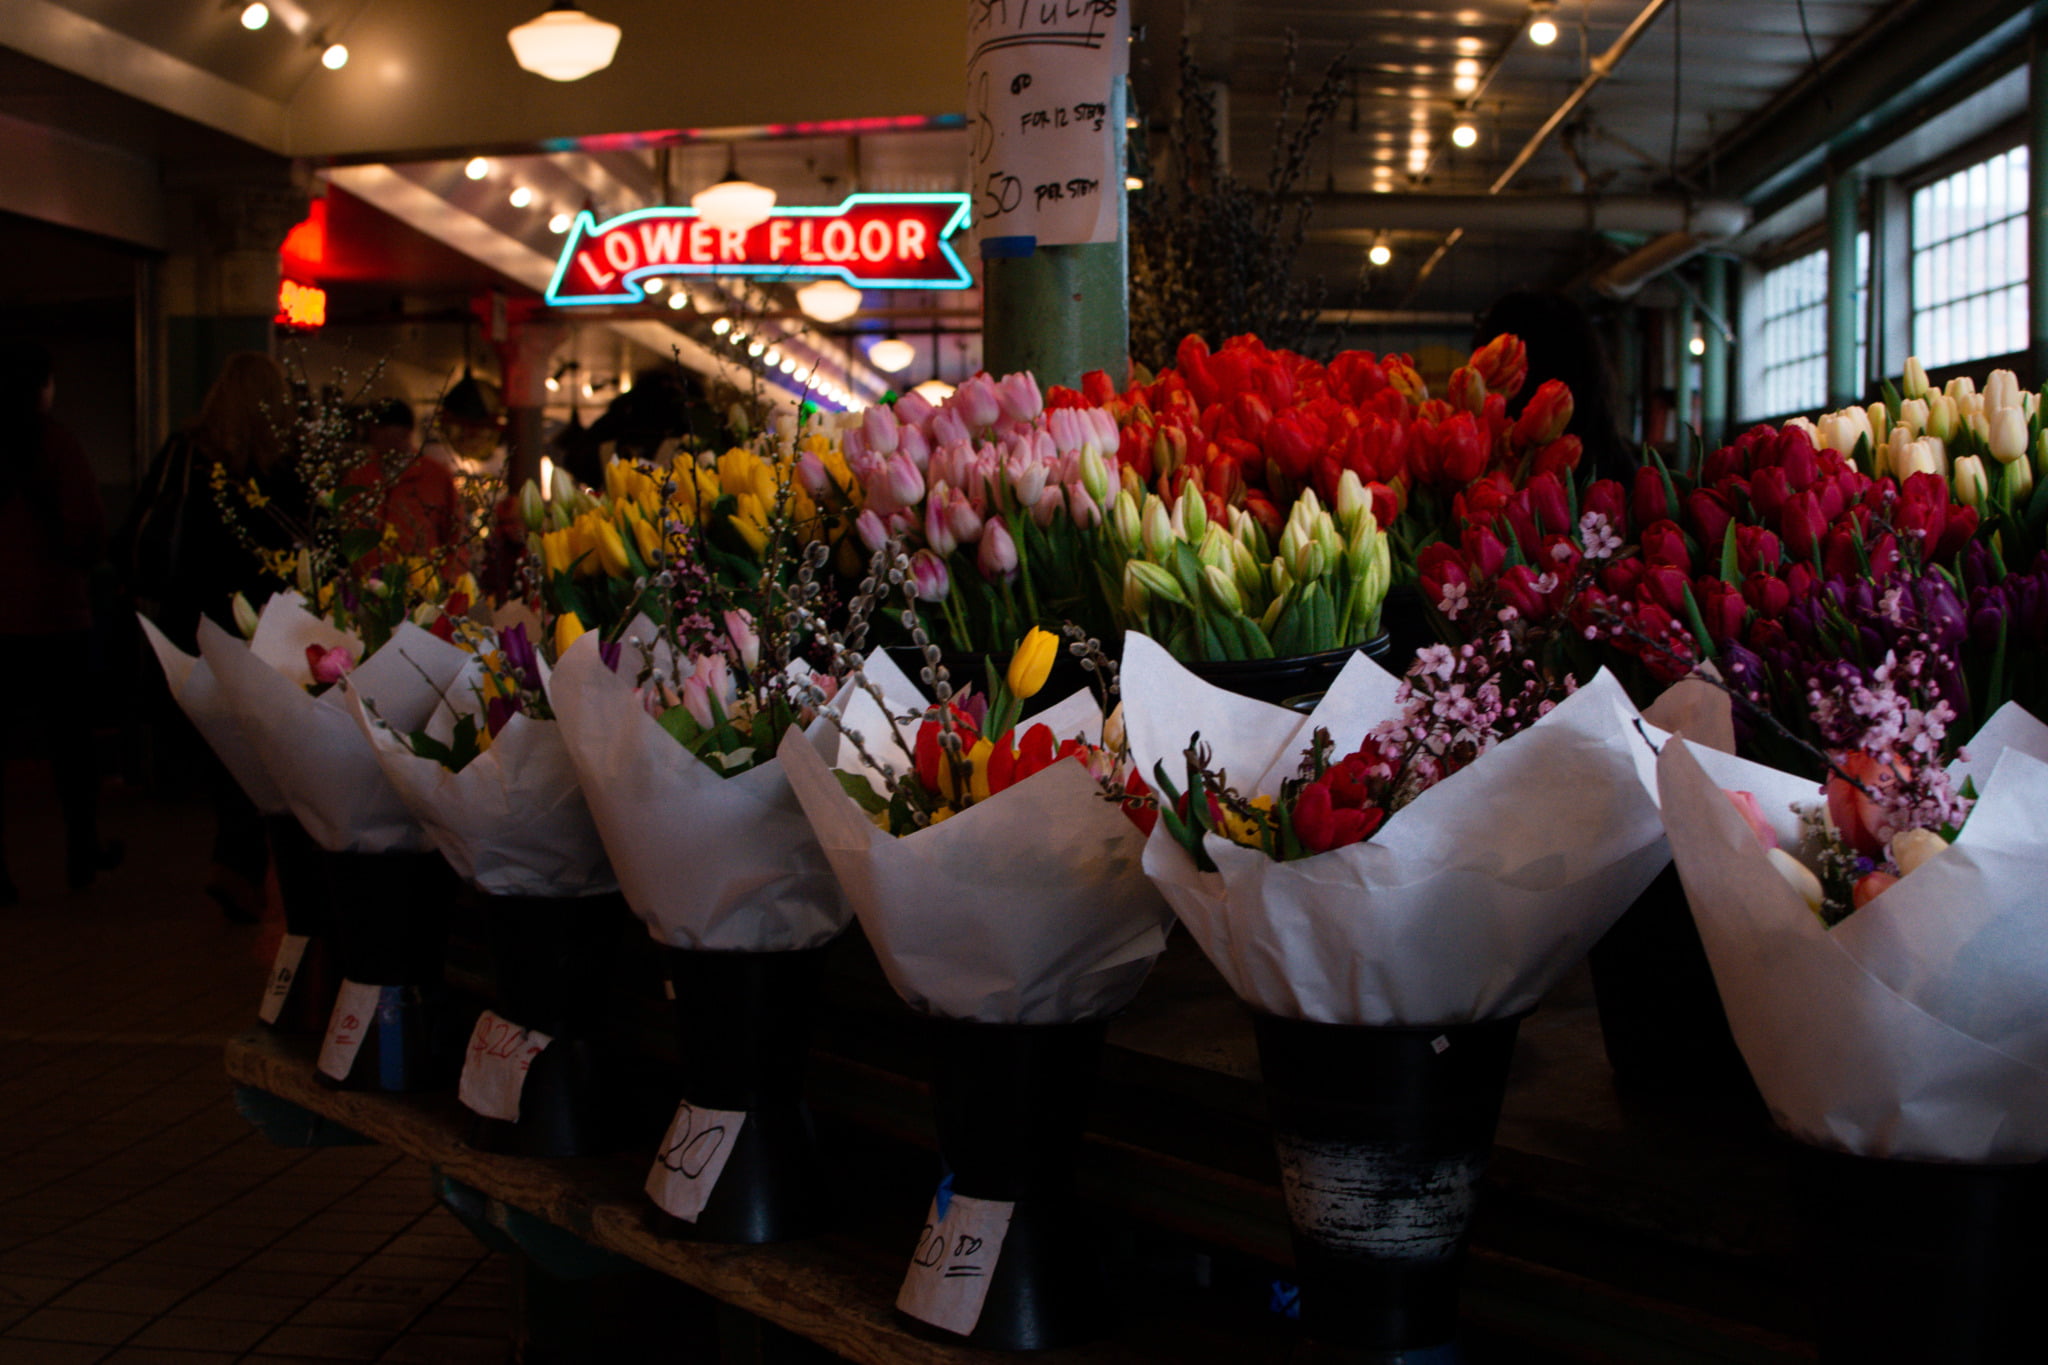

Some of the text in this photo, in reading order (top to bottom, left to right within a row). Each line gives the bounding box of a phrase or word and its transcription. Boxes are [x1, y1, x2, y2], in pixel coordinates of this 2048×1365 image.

[1020, 108, 1050, 134] FOR
[1054, 107, 1069, 128] 12
[1034, 182, 1064, 211] PER
[1066, 178, 1099, 198] STEM
[577, 218, 927, 291] LOWER FLOOR
[659, 1104, 725, 1179] 20
